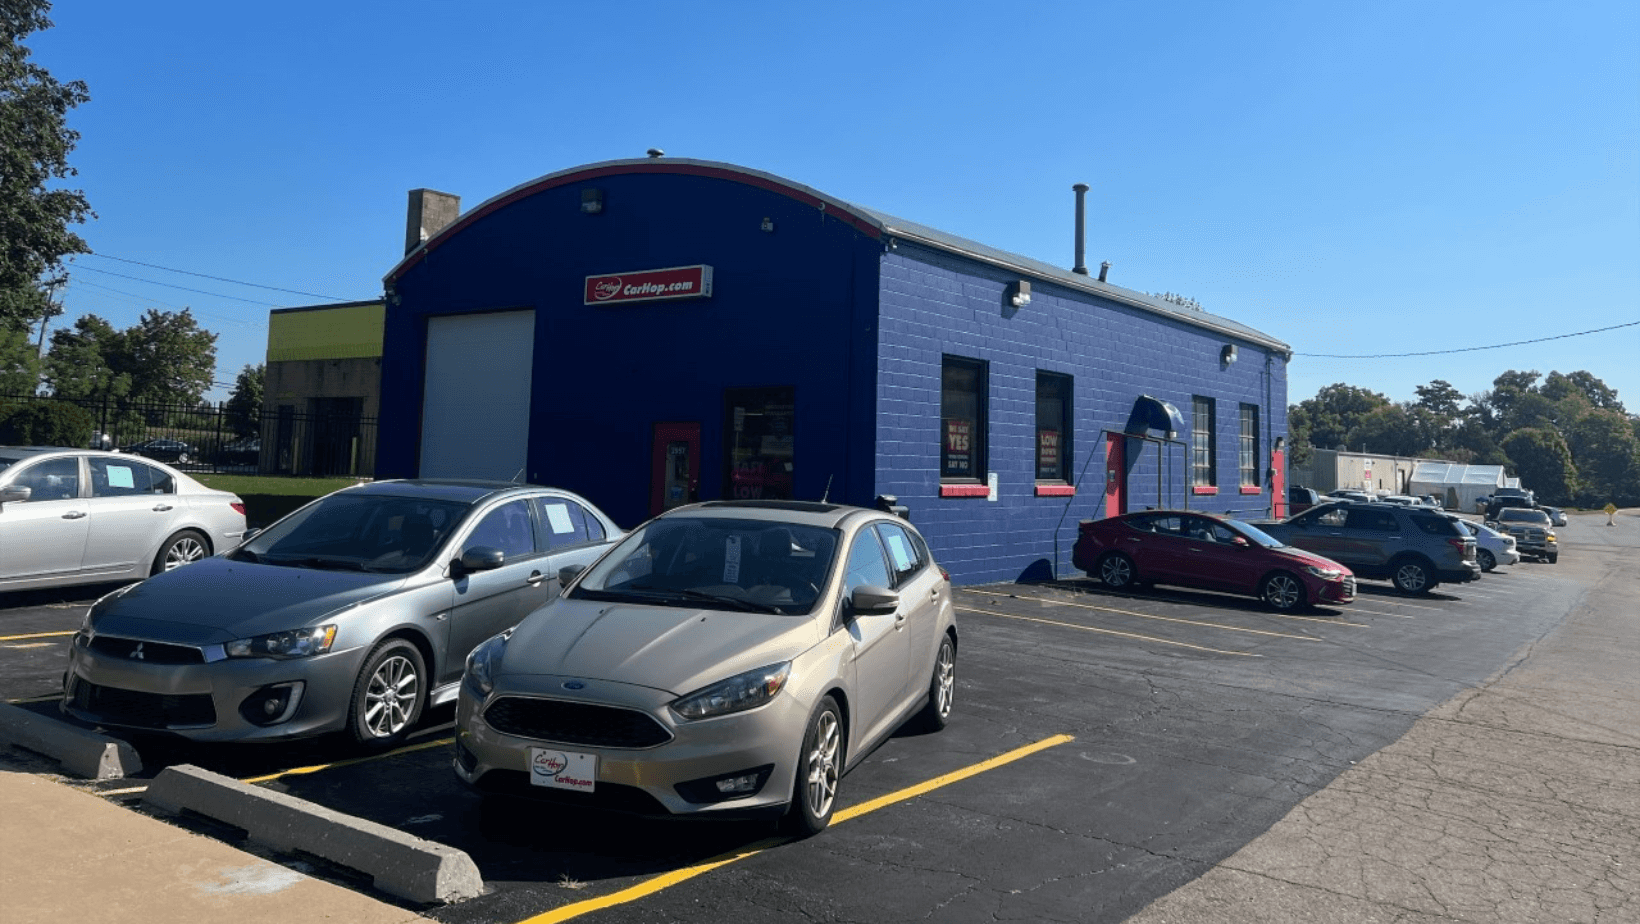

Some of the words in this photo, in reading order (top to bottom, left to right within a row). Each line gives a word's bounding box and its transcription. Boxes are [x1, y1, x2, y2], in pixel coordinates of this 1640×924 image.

[623, 281, 693, 296] CarHop.com
[949, 433, 968, 450] YES
[1041, 435, 1057, 446] LOW
[733, 485, 763, 499] LOW
[555, 775, 593, 786] CarHop.com
